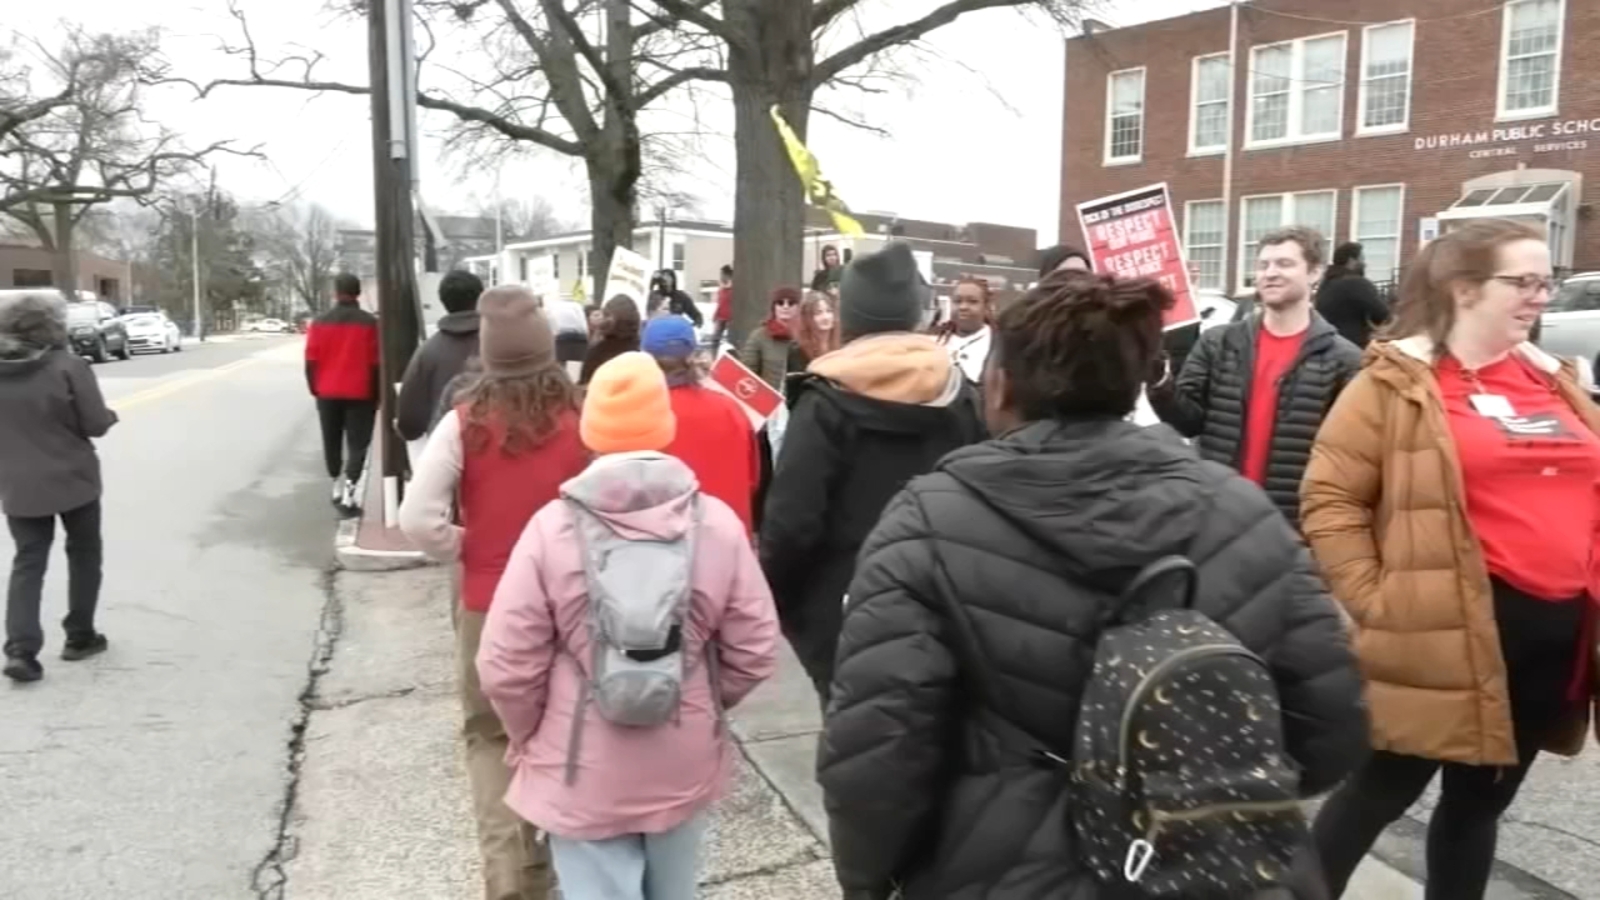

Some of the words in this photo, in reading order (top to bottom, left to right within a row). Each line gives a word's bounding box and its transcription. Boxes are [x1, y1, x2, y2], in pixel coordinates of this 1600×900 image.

[1414, 131, 1488, 150] DURHAM
[1492, 124, 1544, 141] PUBLIC
[1469, 147, 1517, 158] CENTRAL
[1534, 141, 1587, 152] SERVICES
[1096, 211, 1161, 241] RESPECT
[1104, 242, 1170, 272] RESPECT
